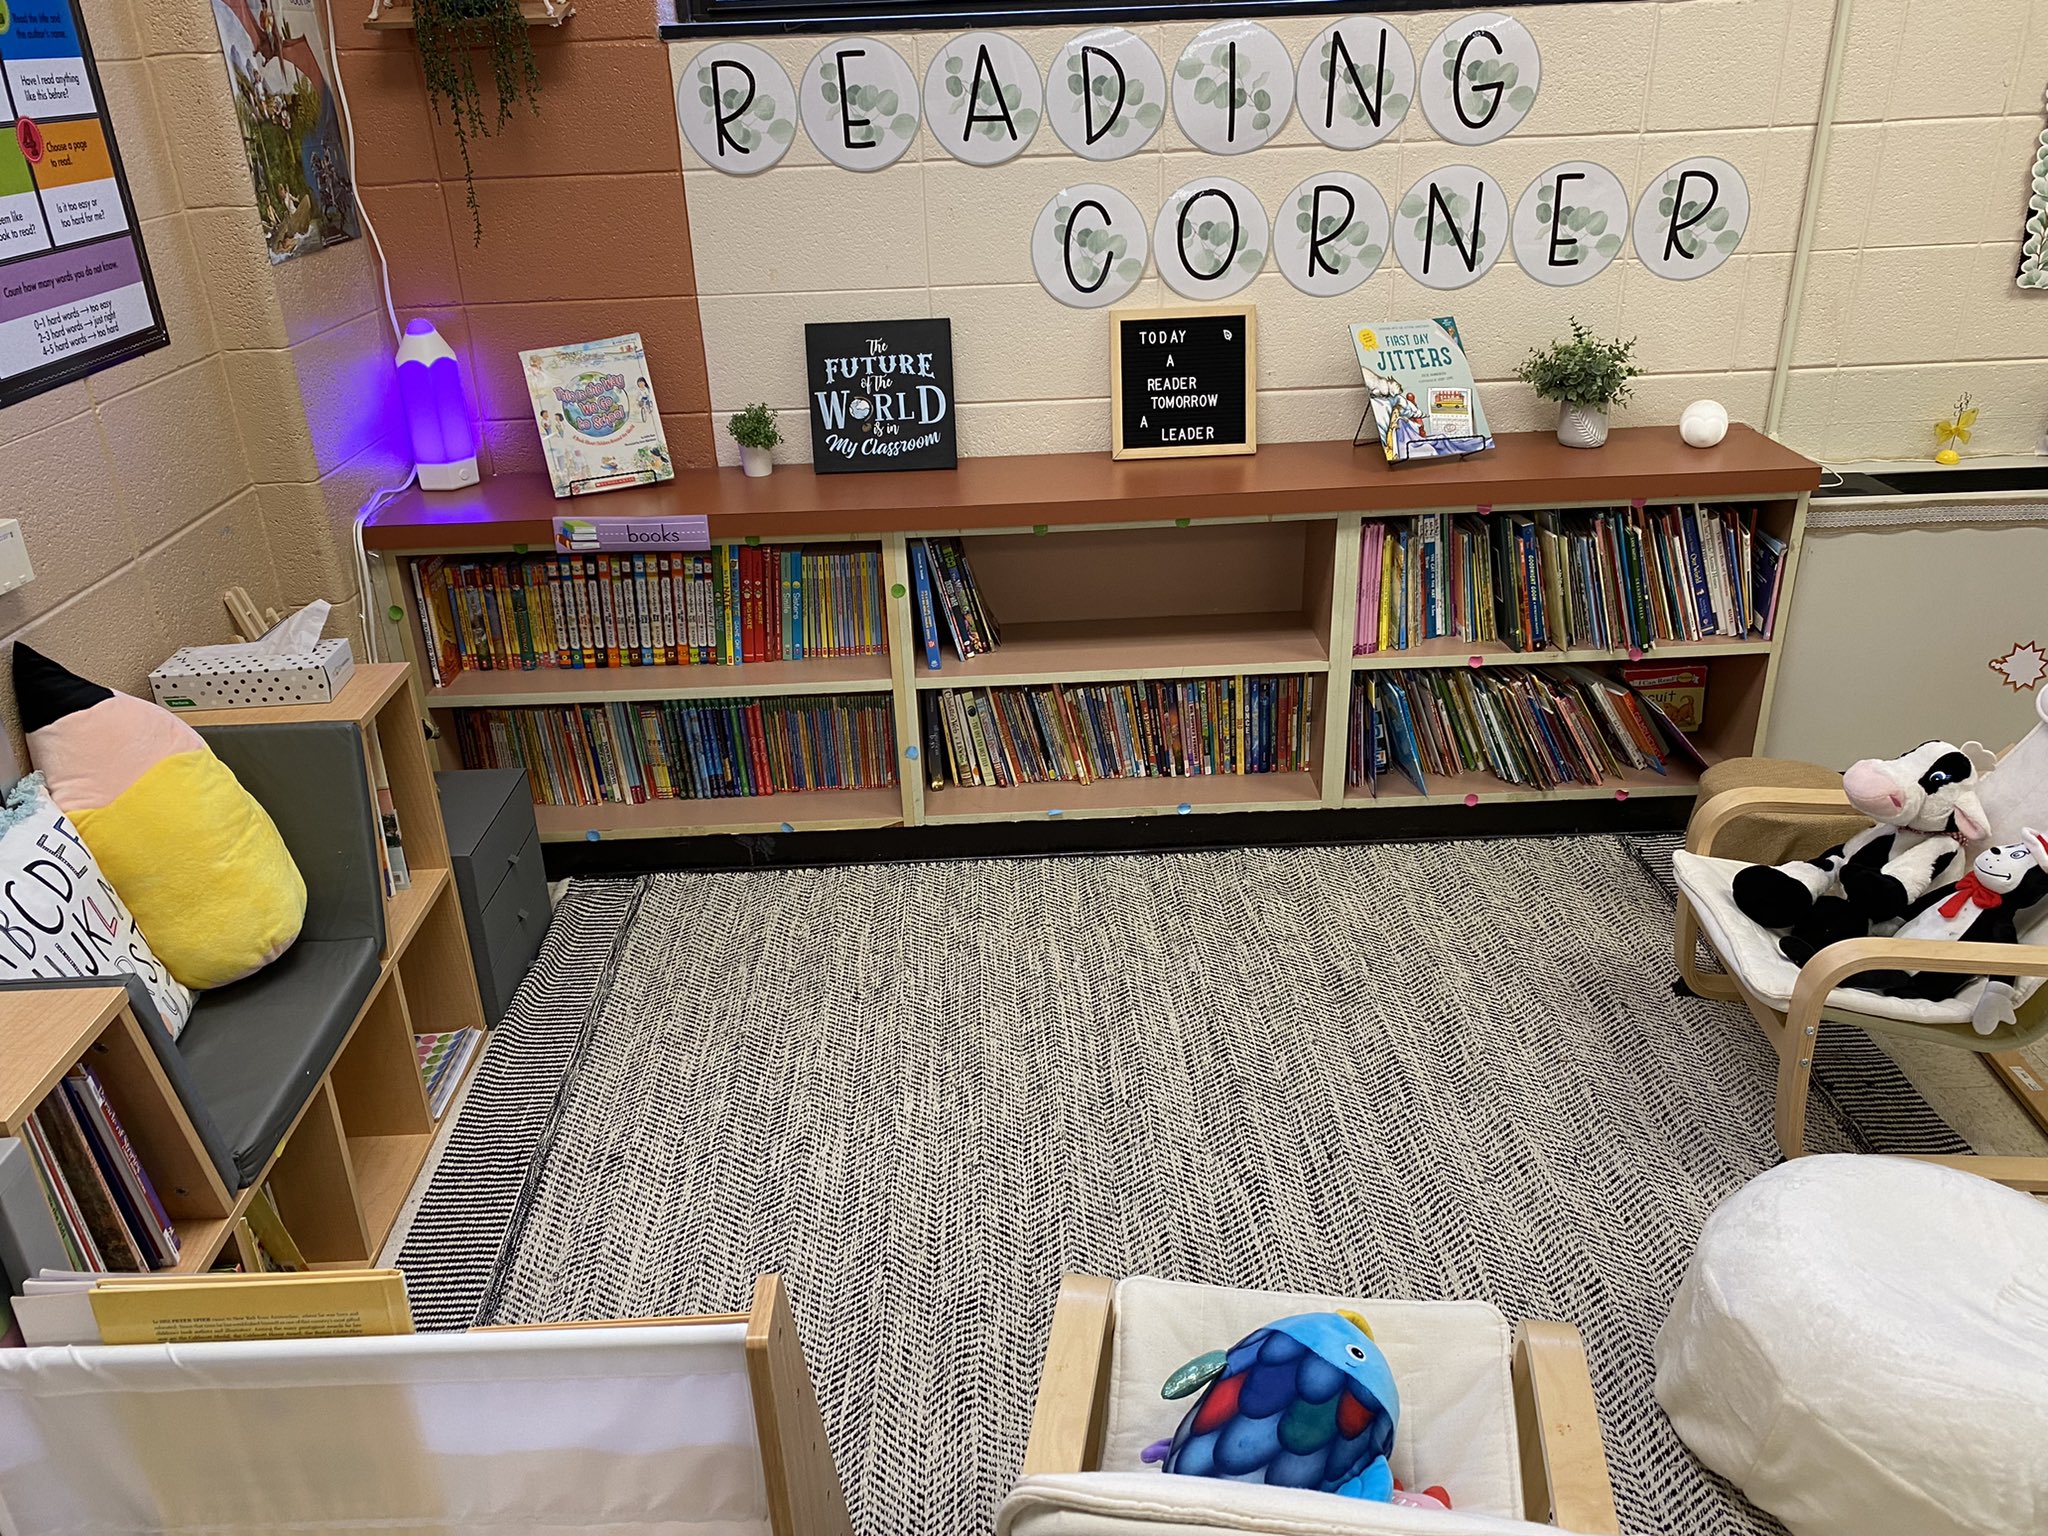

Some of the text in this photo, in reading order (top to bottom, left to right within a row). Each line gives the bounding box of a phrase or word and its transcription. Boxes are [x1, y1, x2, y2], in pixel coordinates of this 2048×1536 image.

[20, 74, 36, 86] Have
[42, 73, 54, 85] read
[55, 72, 80, 86] anything
[24, 88, 69, 101] like this before?
[711, 28, 1505, 157] READING
[46, 140, 88, 152] Choose a page
[50, 154, 73, 168] to read.
[56, 198, 98, 214] Is it too easy or
[0, 210, 24, 225] eem like
[60, 209, 105, 228] too hard for me?
[0, 223, 36, 241] ook to read?
[1064, 174, 1718, 293] CORNER
[3, 260, 118, 298] Count how many words you do not know.
[33, 317, 45, 330] 0-1
[46, 312, 61, 327] hard
[61, 306, 80, 320] words
[99, 300, 112, 311] easy
[37, 310, 116, 343] 2-3 hard words just right
[55, 338, 69, 351] hard
[70, 333, 88, 346] words
[97, 329, 106, 338] too
[107, 321, 119, 334] hard
[1139, 330, 1186, 344] TODAY
[1385, 334, 1410, 346] FIRST
[1413, 333, 1429, 345] DAY
[866, 337, 888, 356] The
[1166, 354, 1175, 367] A
[1377, 347, 1452, 371] JITTERS
[824, 353, 936, 384] FUTURE
[860, 377, 872, 395] of
[1147, 376, 1197, 391] READER
[578, 396, 613, 416] We Go
[1150, 394, 1218, 409] TOMORROW
[592, 405, 626, 430] School
[1140, 416, 1148, 428] A
[872, 423, 900, 436] is in
[1161, 426, 1214, 441] LEADER
[825, 431, 942, 459] My Classroom
[626, 524, 680, 543] books
[782, 593, 790, 614] Smile
[792, 592, 801, 619] Sisters
